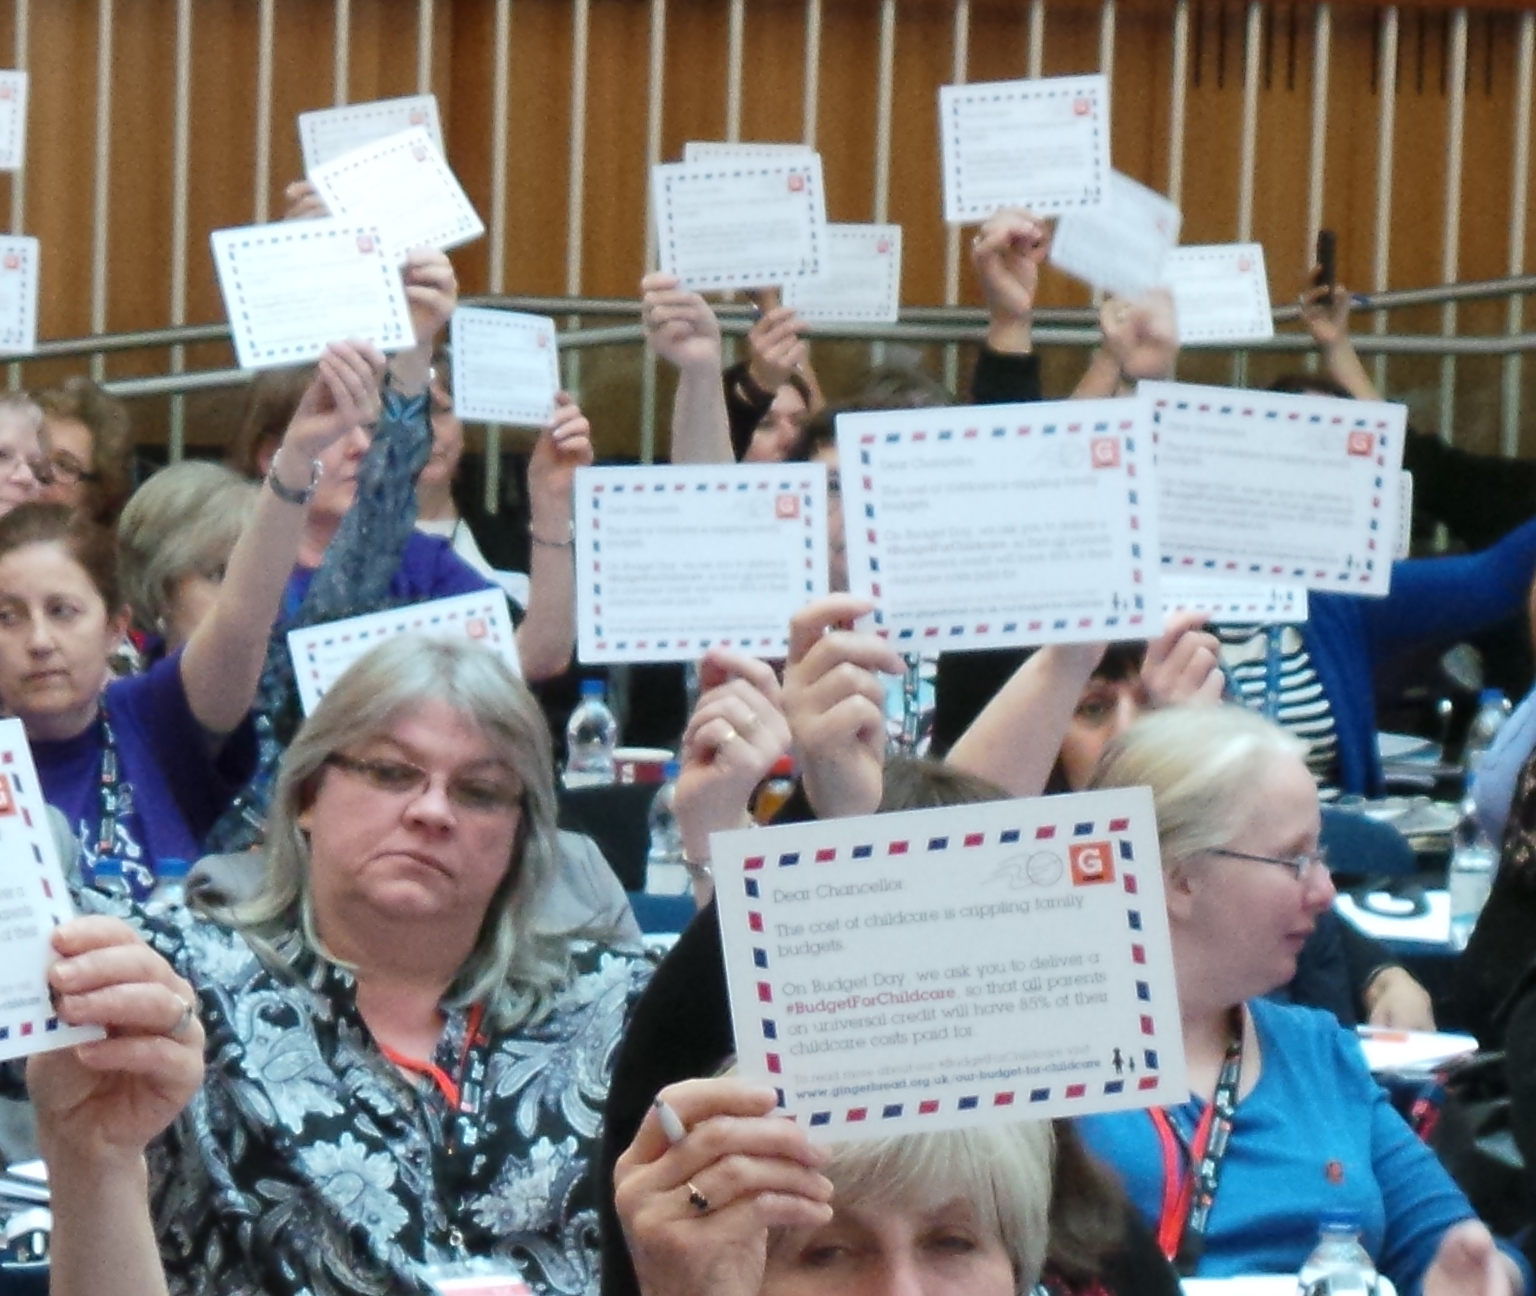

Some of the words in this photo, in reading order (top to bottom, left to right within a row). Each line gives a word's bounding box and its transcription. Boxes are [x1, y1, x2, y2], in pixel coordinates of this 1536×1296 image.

[1076, 848, 1103, 875] G
[773, 888, 811, 902] Dear
[775, 922, 805, 936] The
[809, 917, 840, 933] cost
[843, 915, 860, 929] of
[863, 910, 939, 927] childcare
[942, 908, 956, 920] is
[958, 901, 1031, 919] crippling
[1034, 894, 1085, 910] family
[963, 985, 982, 997] so
[984, 980, 1018, 994] that
[1020, 976, 1042, 992] all
[1046, 971, 1107, 991] parents
